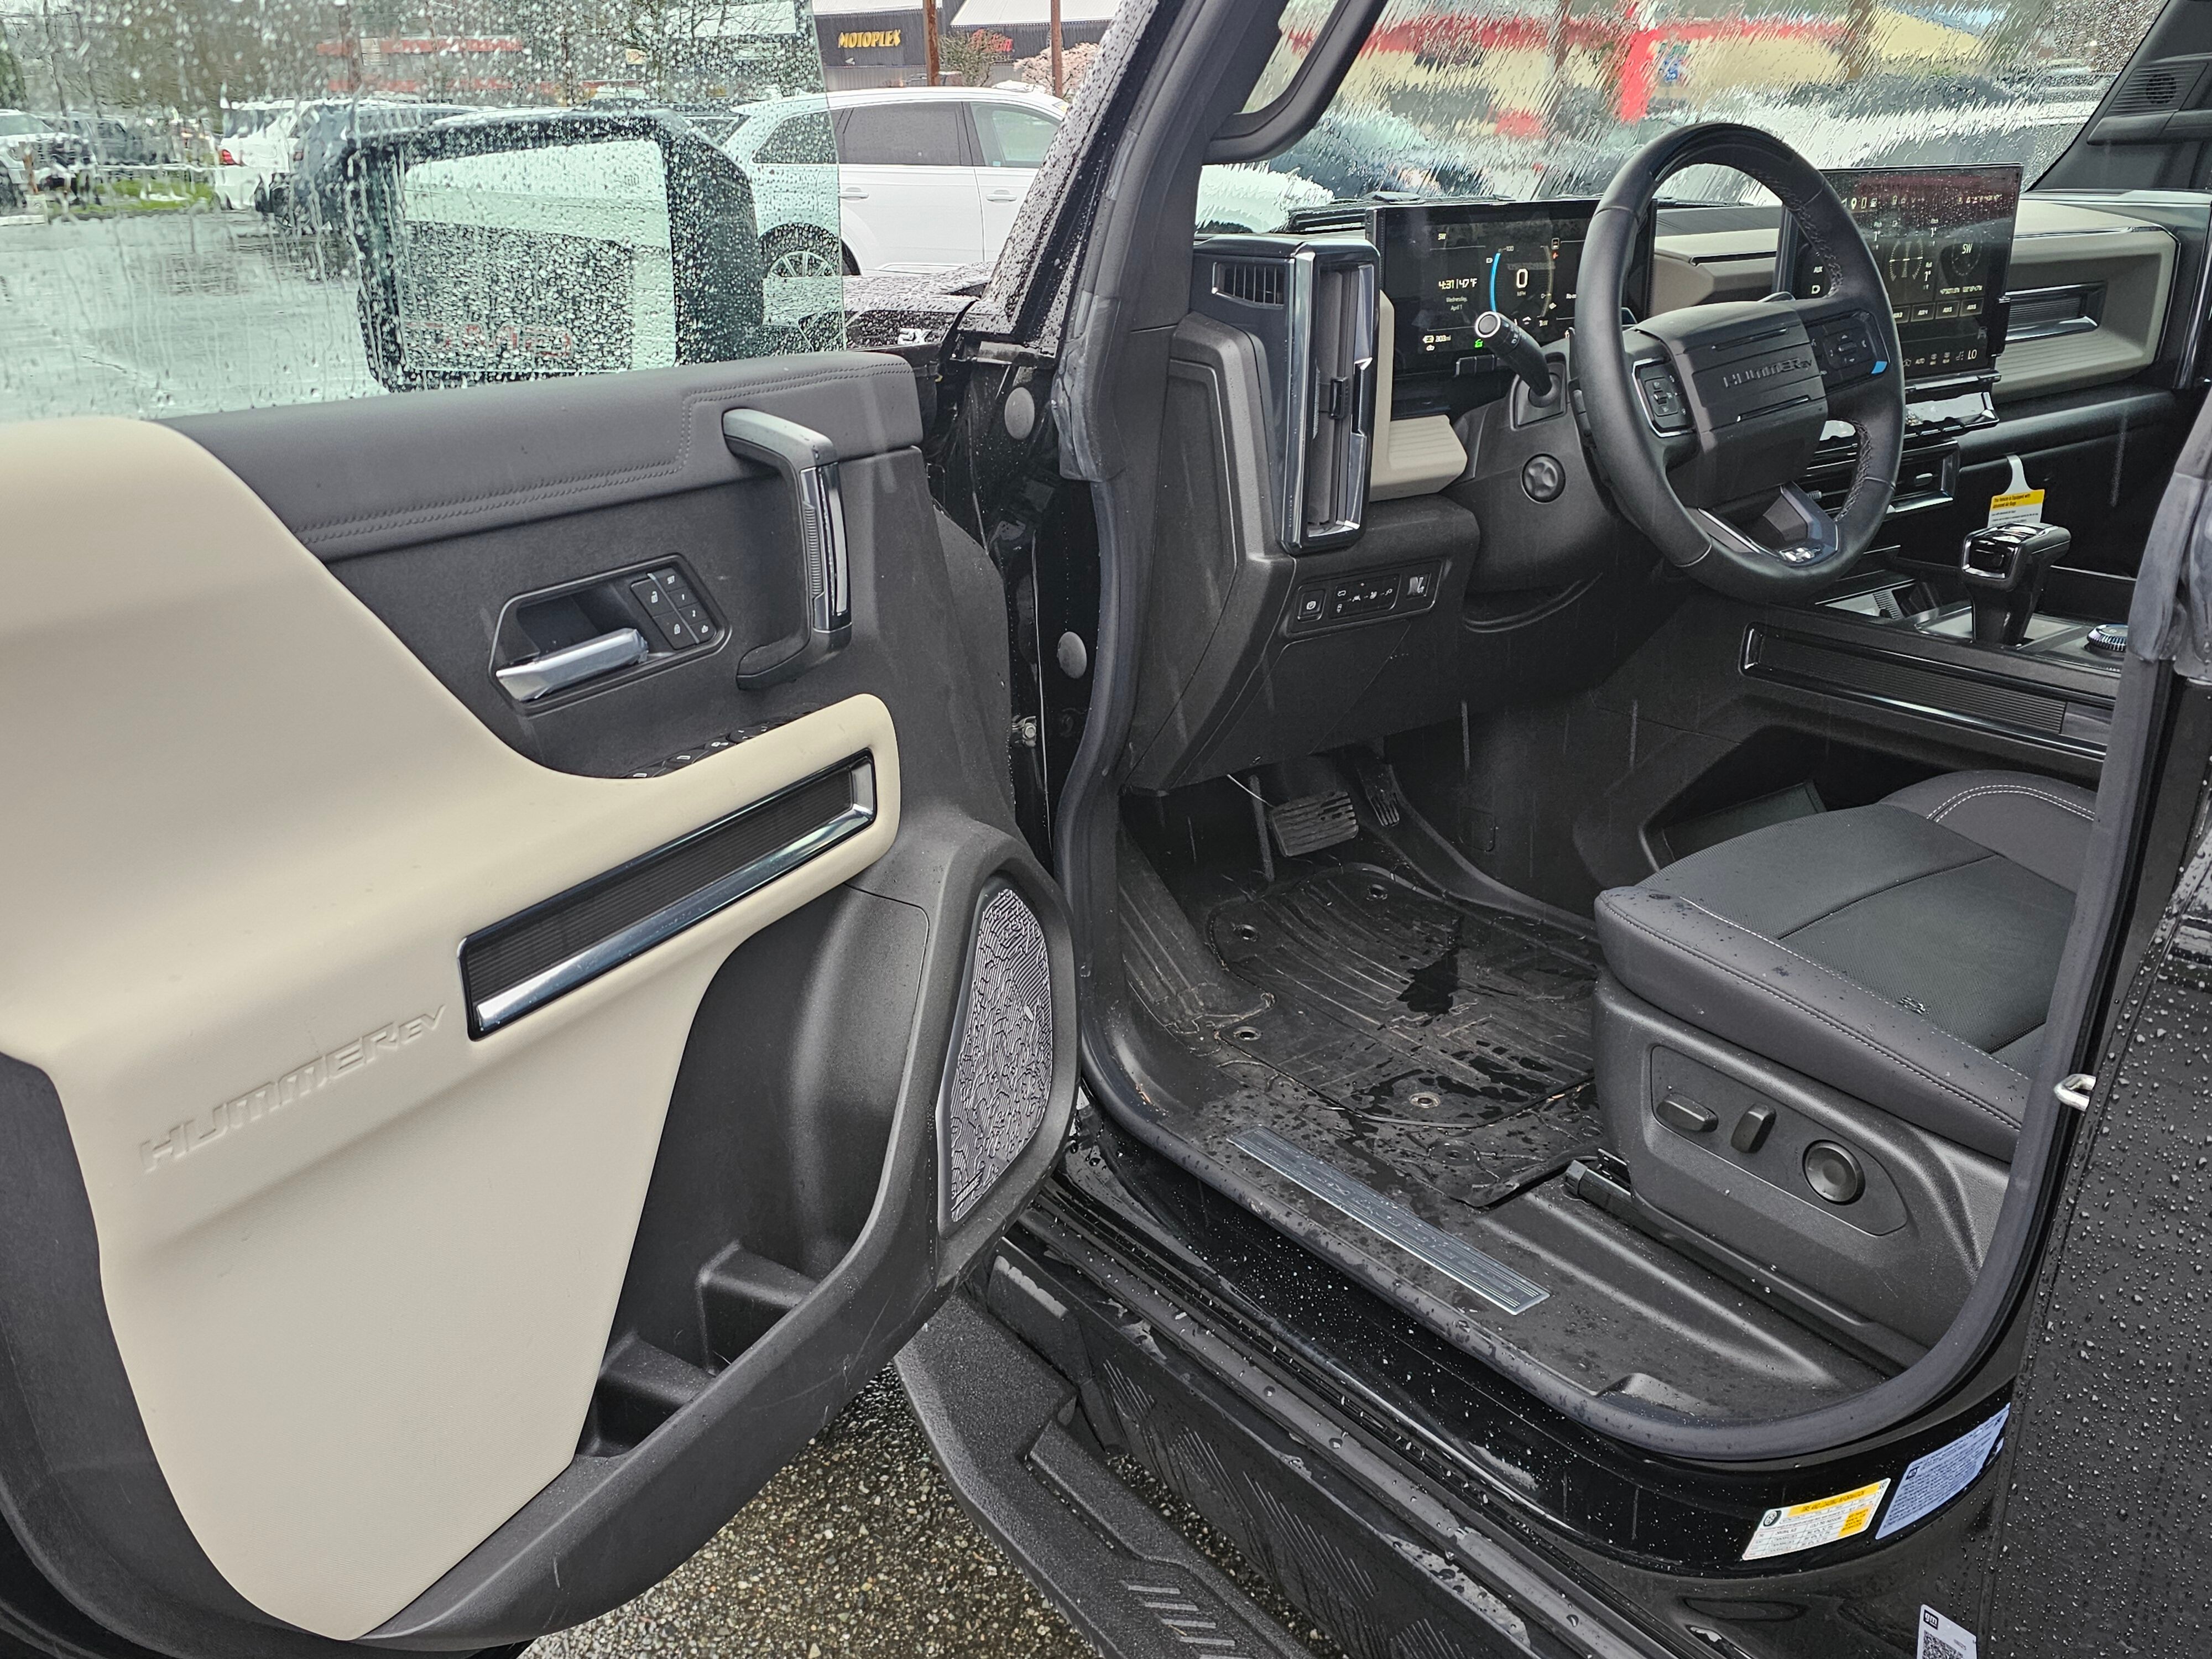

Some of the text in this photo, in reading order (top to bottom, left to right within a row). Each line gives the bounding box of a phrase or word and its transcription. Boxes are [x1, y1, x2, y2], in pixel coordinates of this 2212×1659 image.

[838, 29, 901, 48] MOTOPLEX
[1962, 243, 1973, 254] SW
[1438, 280, 1454, 290] 4:31
[1516, 268, 1528, 288] 0
[898, 327, 932, 345] 2X
[1968, 349, 1978, 360] LO
[139, 1021, 398, 1174] HUMMER
[1924, 1612, 1938, 1627] gm
